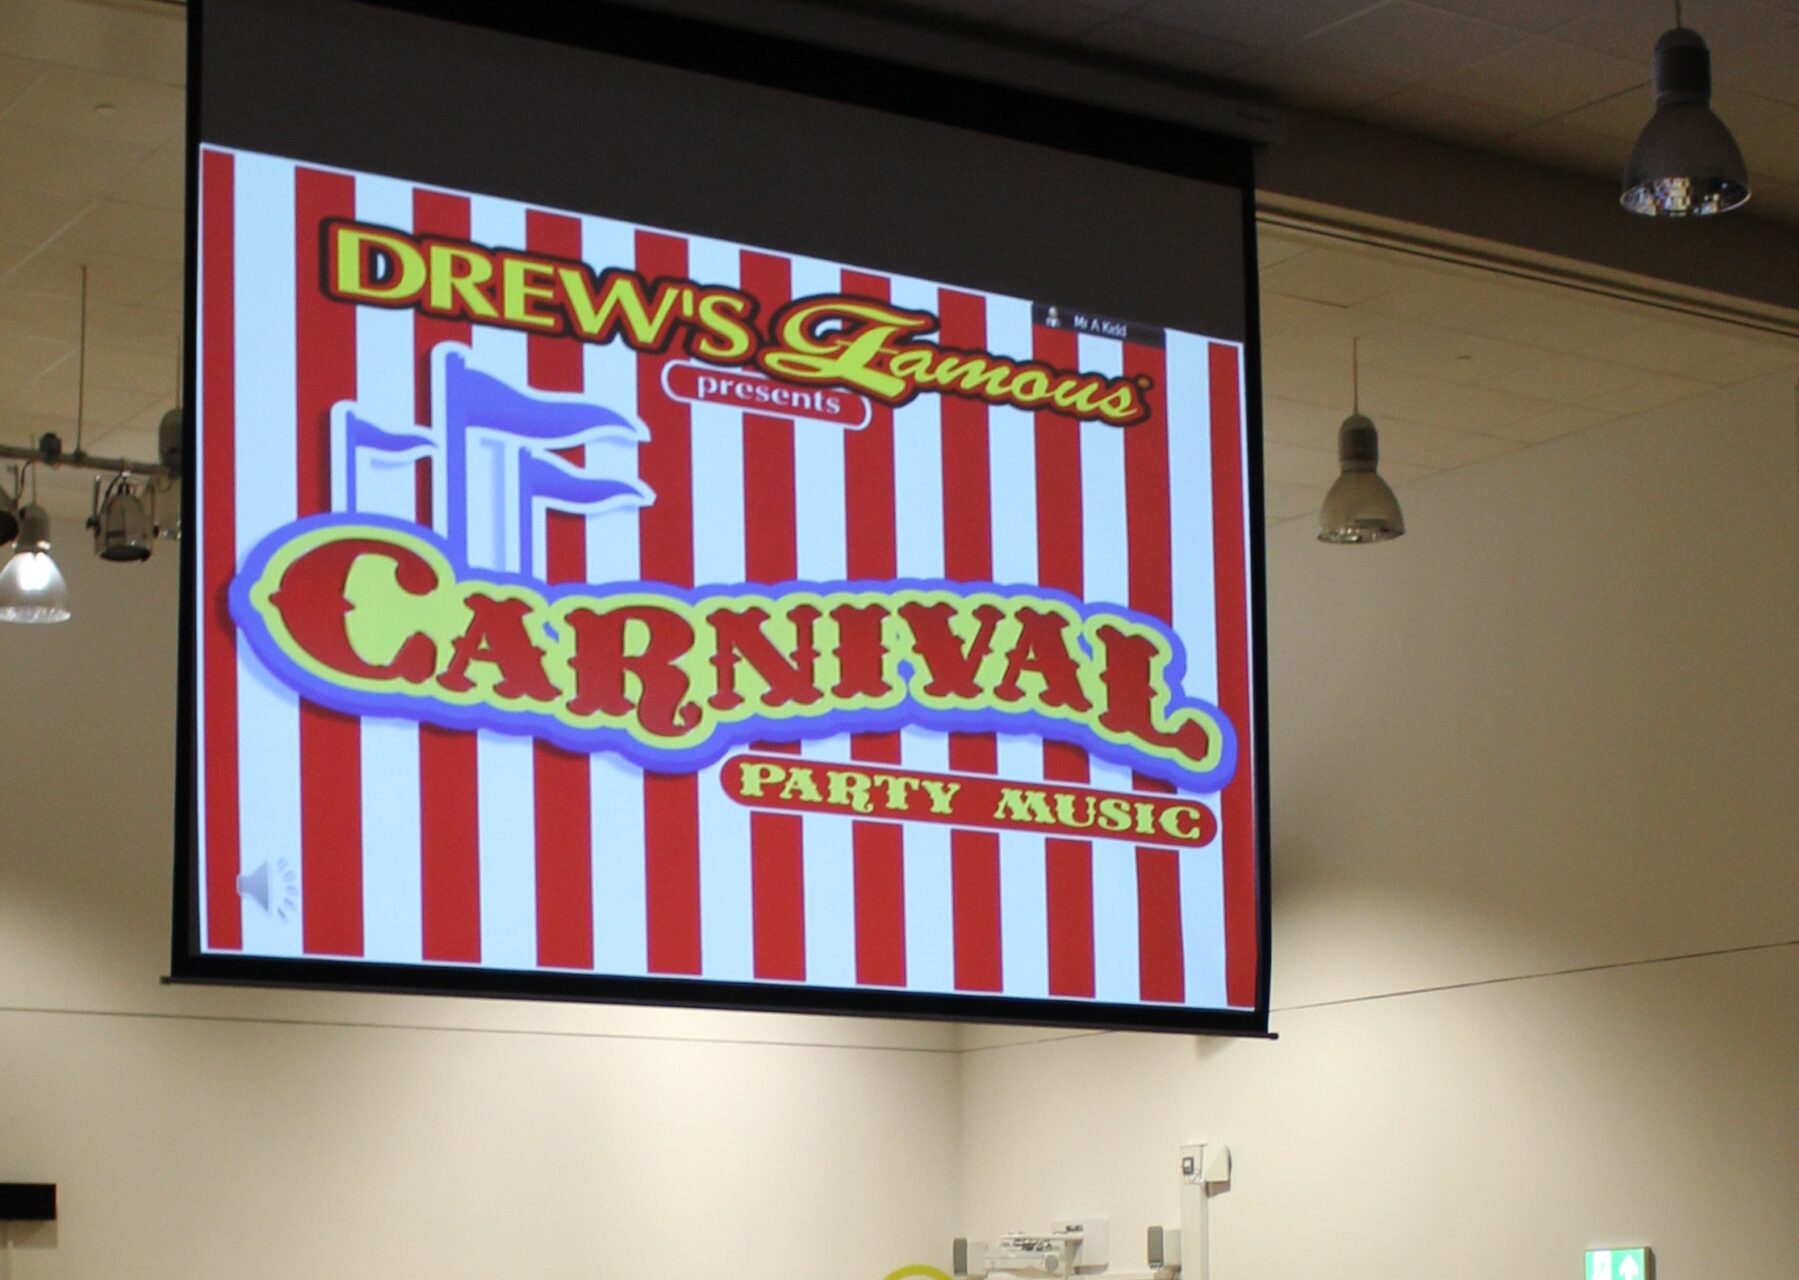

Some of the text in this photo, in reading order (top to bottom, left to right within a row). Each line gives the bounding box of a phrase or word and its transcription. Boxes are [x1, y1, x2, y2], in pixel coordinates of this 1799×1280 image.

[332, 223, 1140, 419] DREW'S Famous
[1073, 314, 1088, 330] Mr
[1091, 318, 1100, 332] A
[697, 374, 842, 415] presents
[268, 537, 1209, 762] CARNIVAL
[738, 761, 1202, 840] PARTY MUSIC
